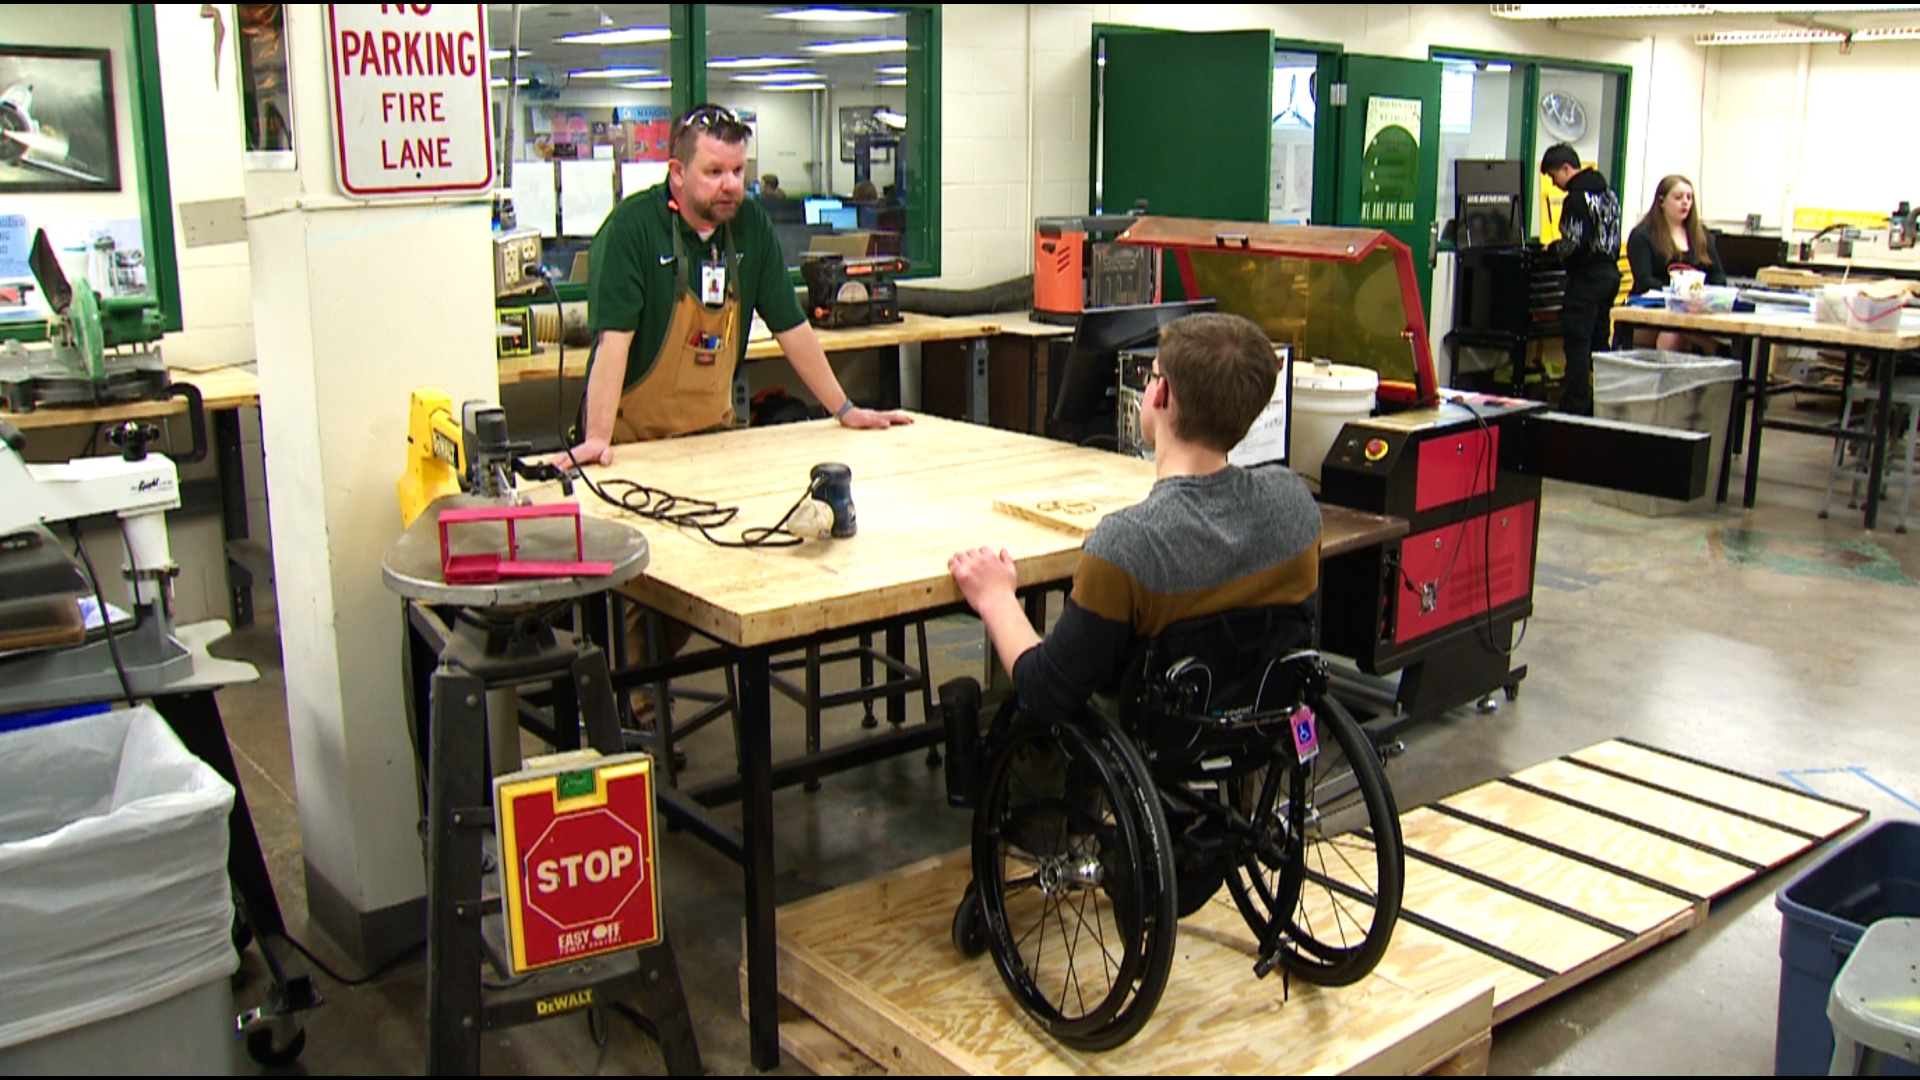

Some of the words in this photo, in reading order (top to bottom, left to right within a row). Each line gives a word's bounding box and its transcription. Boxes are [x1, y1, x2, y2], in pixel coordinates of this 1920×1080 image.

[341, 30, 476, 77] PARKING
[382, 92, 445, 123] FIRE
[381, 138, 452, 170] LANE
[536, 845, 633, 894] STOP
[558, 928, 590, 948] EASY
